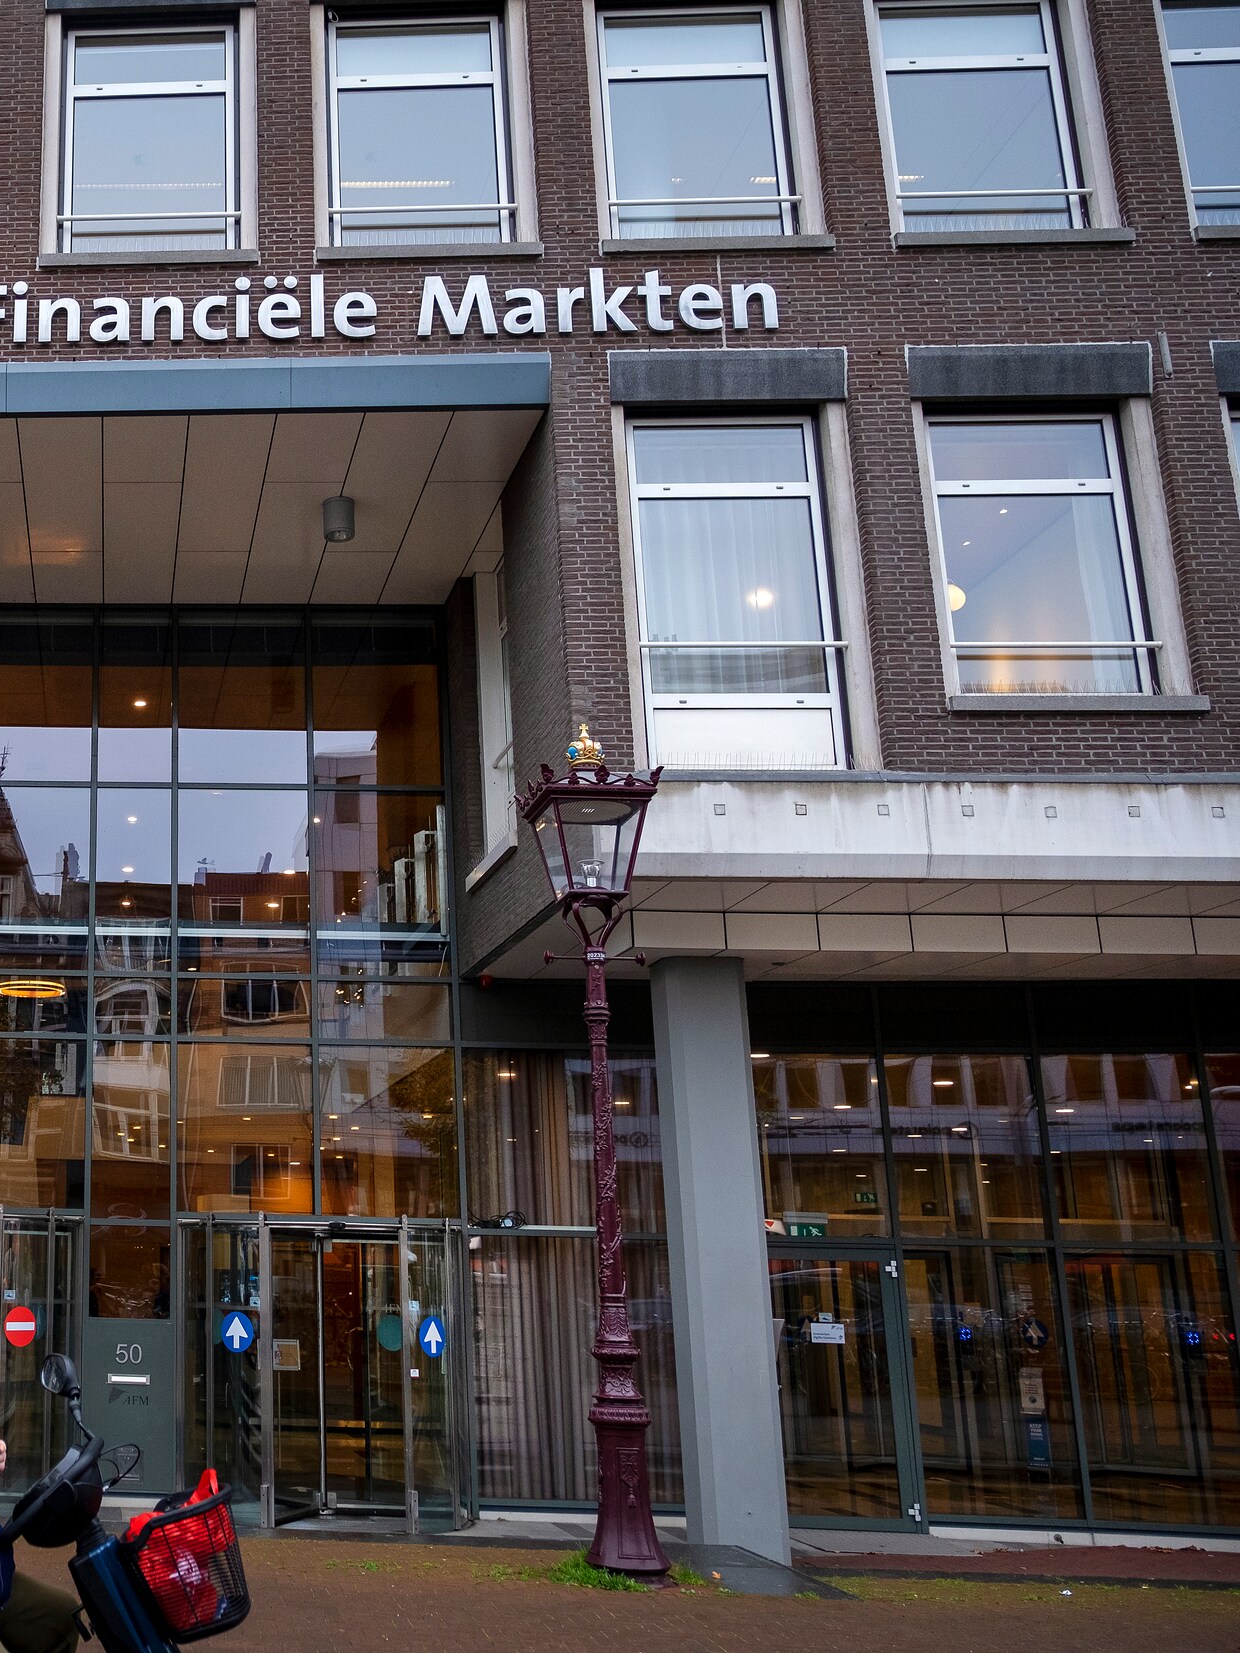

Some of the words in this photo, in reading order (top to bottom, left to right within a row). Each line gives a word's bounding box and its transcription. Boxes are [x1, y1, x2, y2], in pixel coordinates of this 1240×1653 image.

[417, 267, 779, 337] Markten
[115, 1343, 143, 1364] 50
[122, 1395, 150, 1406] AFM
